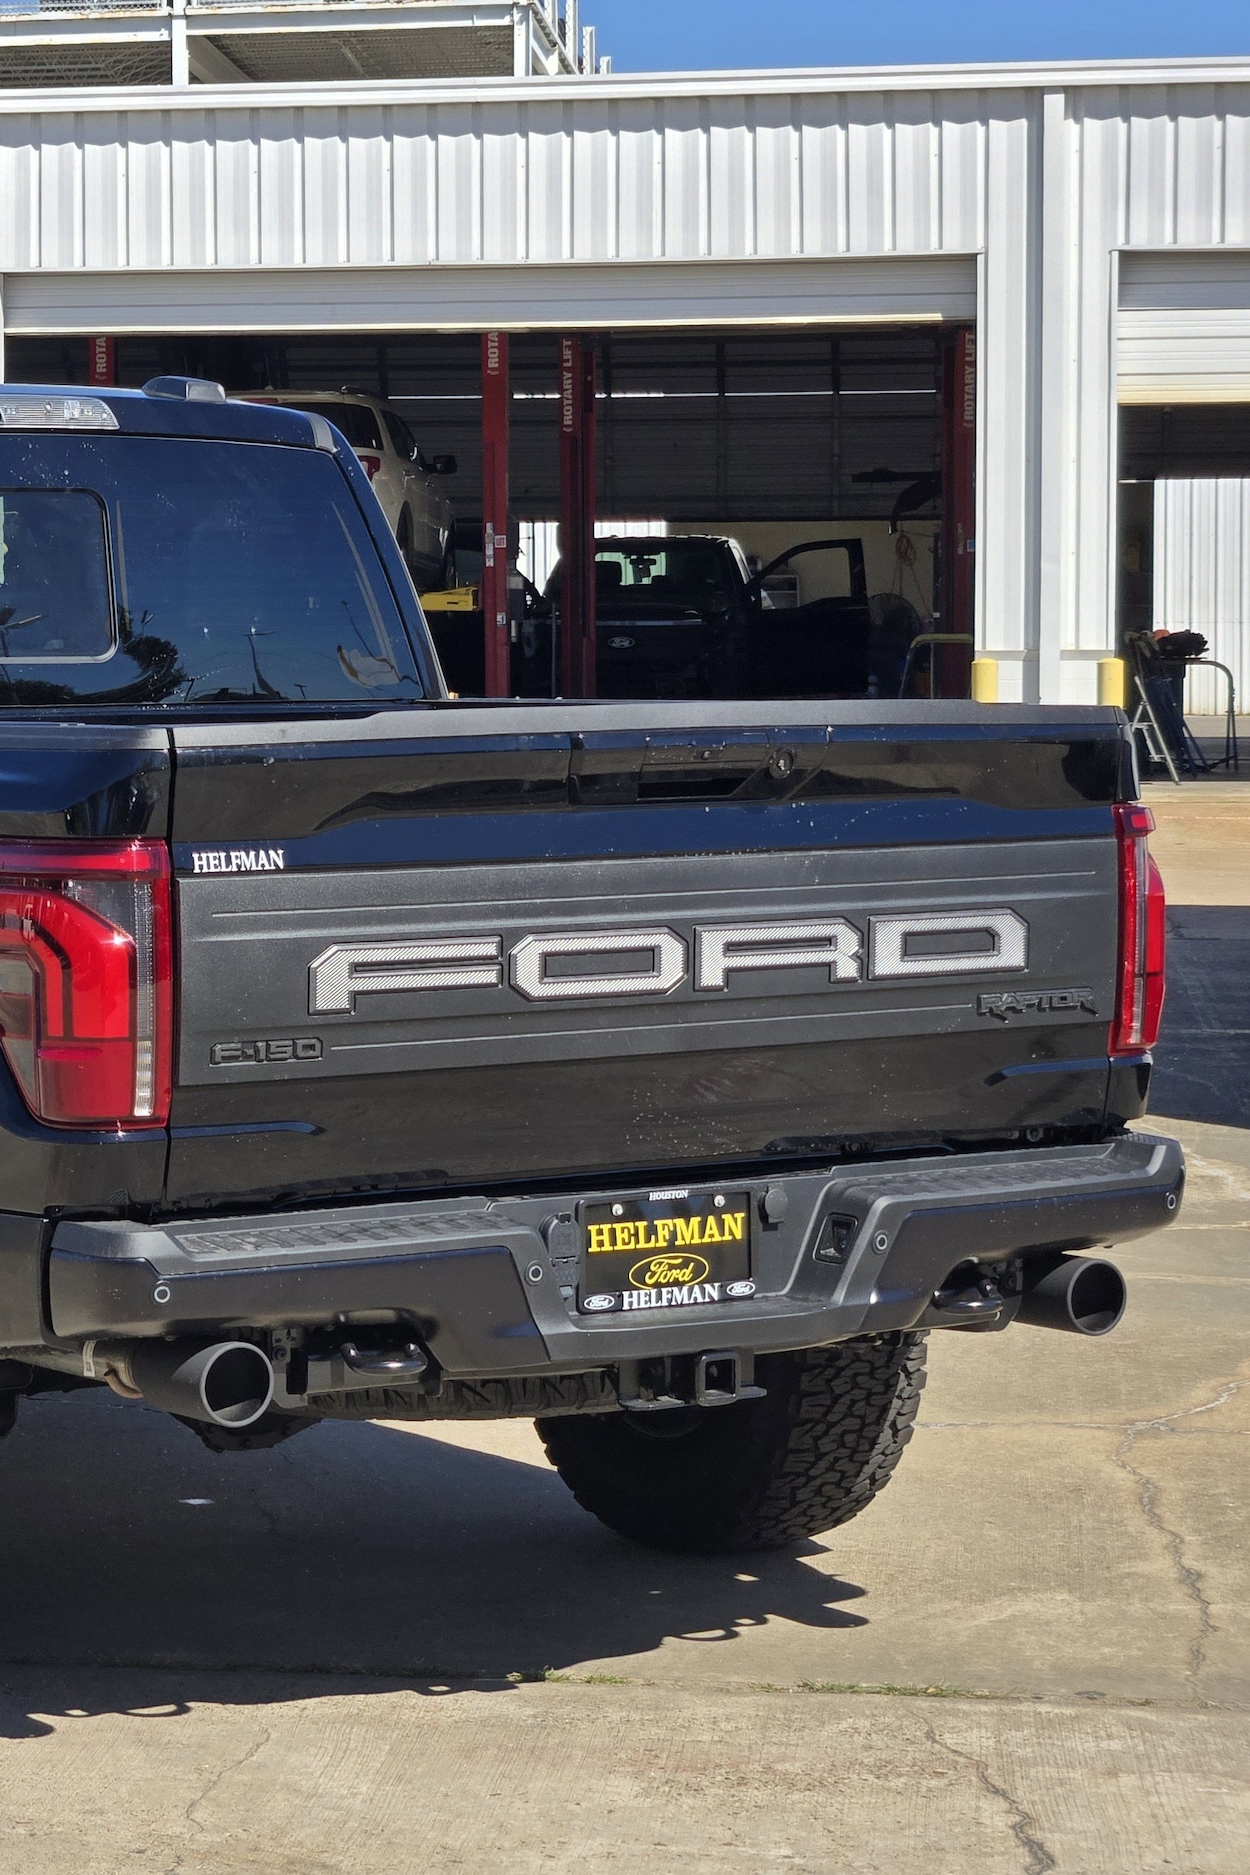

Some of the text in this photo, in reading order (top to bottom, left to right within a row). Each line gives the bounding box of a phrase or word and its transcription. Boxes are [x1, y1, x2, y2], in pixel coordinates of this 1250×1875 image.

[563, 339, 573, 425] ROTARY LIFT
[964, 366, 975, 420] ROTARY
[191, 849, 284, 873] HELFMAN
[308, 908, 1029, 1016] FORD
[978, 987, 1099, 1024] RAPTOR
[210, 1037, 323, 1067] F-150
[649, 1190, 689, 1201] HOUSTON
[587, 1212, 746, 1253] HELFMAN
[644, 1257, 695, 1286] Ford
[621, 1282, 721, 1310] HELFMAN
